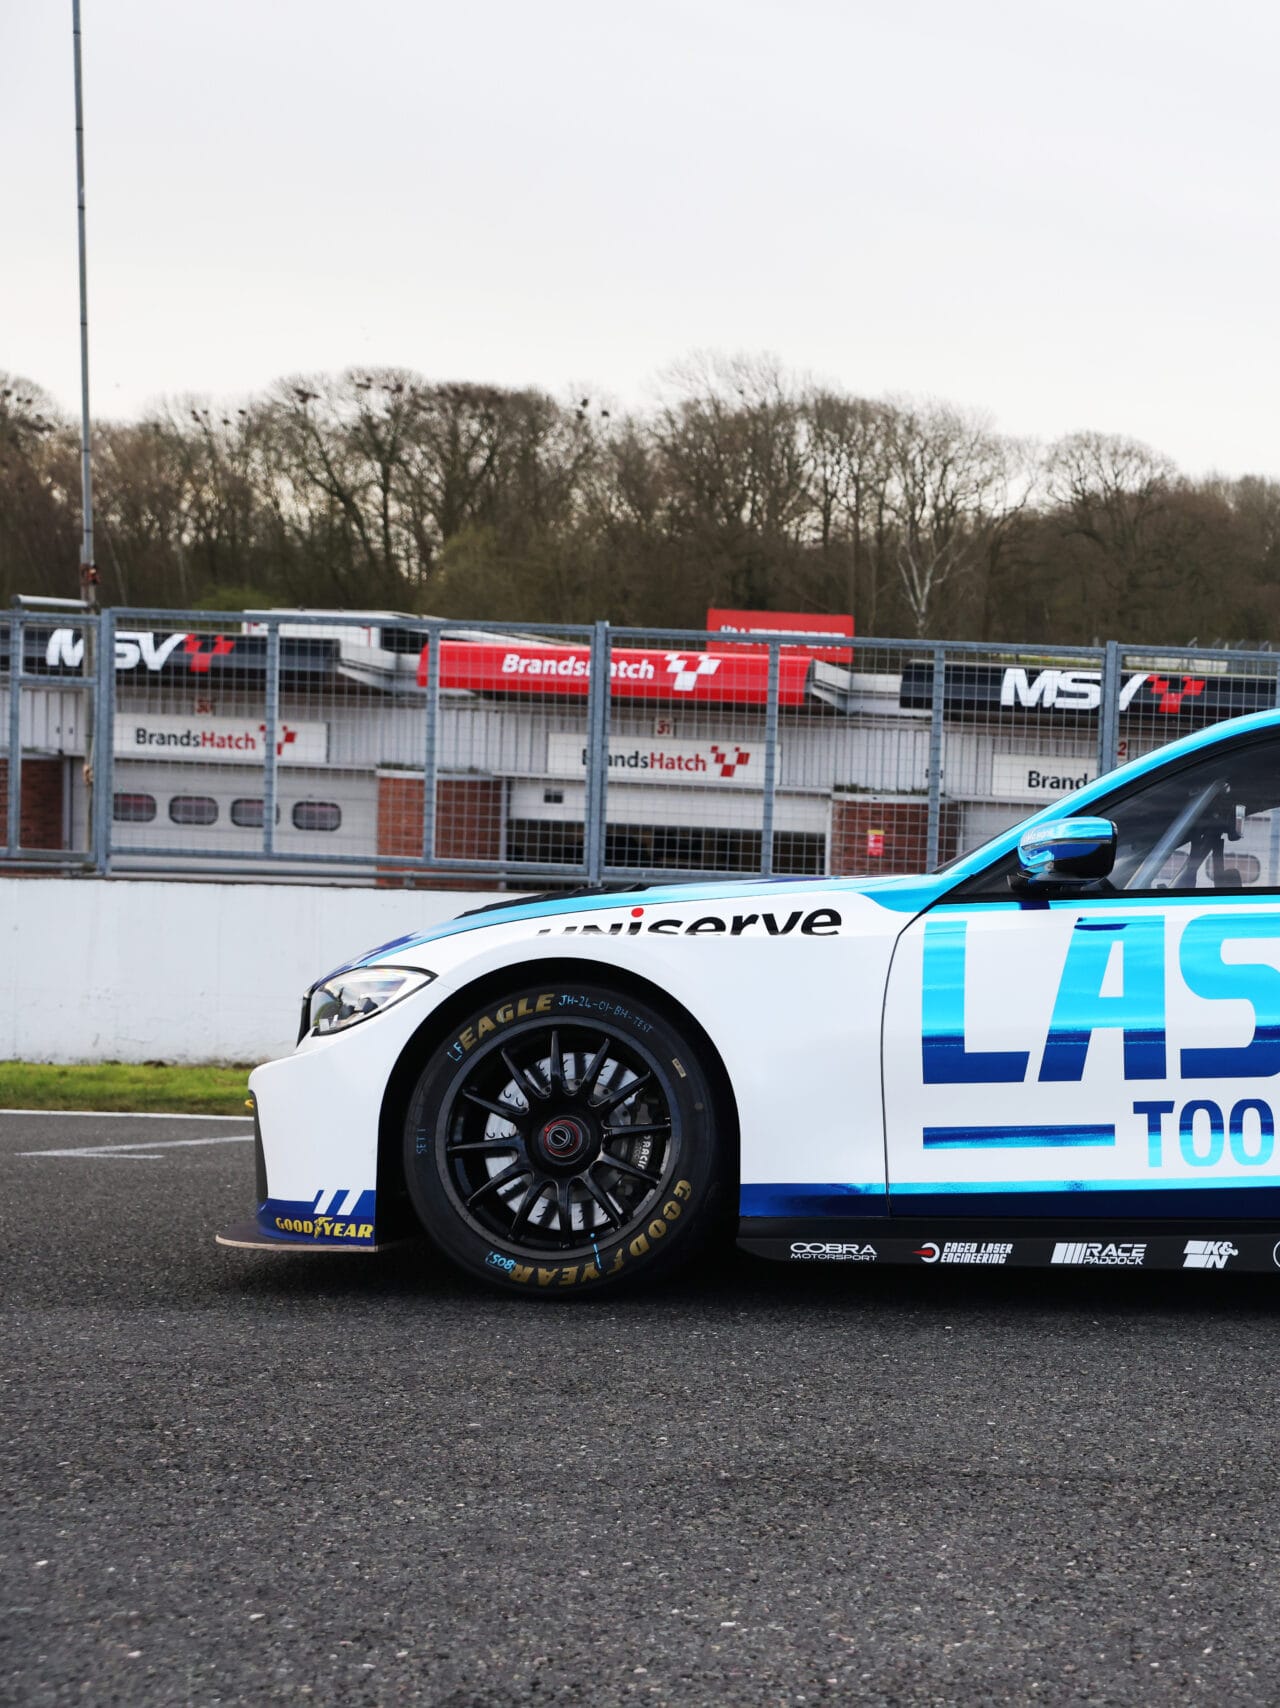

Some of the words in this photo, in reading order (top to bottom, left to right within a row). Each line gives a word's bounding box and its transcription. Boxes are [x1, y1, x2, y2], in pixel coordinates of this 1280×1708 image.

[501, 653, 655, 680] Brandsatch
[136, 727, 256, 751] BrandsHatch
[1116, 741, 1127, 756] 2
[1027, 769, 1094, 790] Brand
[536, 907, 842, 937] iserve
[458, 993, 556, 1051] EAGLE
[790, 1242, 877, 1254] COBRA
[943, 1242, 978, 1254] CAGED
[980, 1243, 1014, 1255] LASER
[1085, 1243, 1148, 1257] RACE
[790, 1253, 877, 1261] MOTORSPORT
[940, 1253, 1008, 1264] ENGINEERING
[1083, 1256, 1145, 1265] PADDOCK
